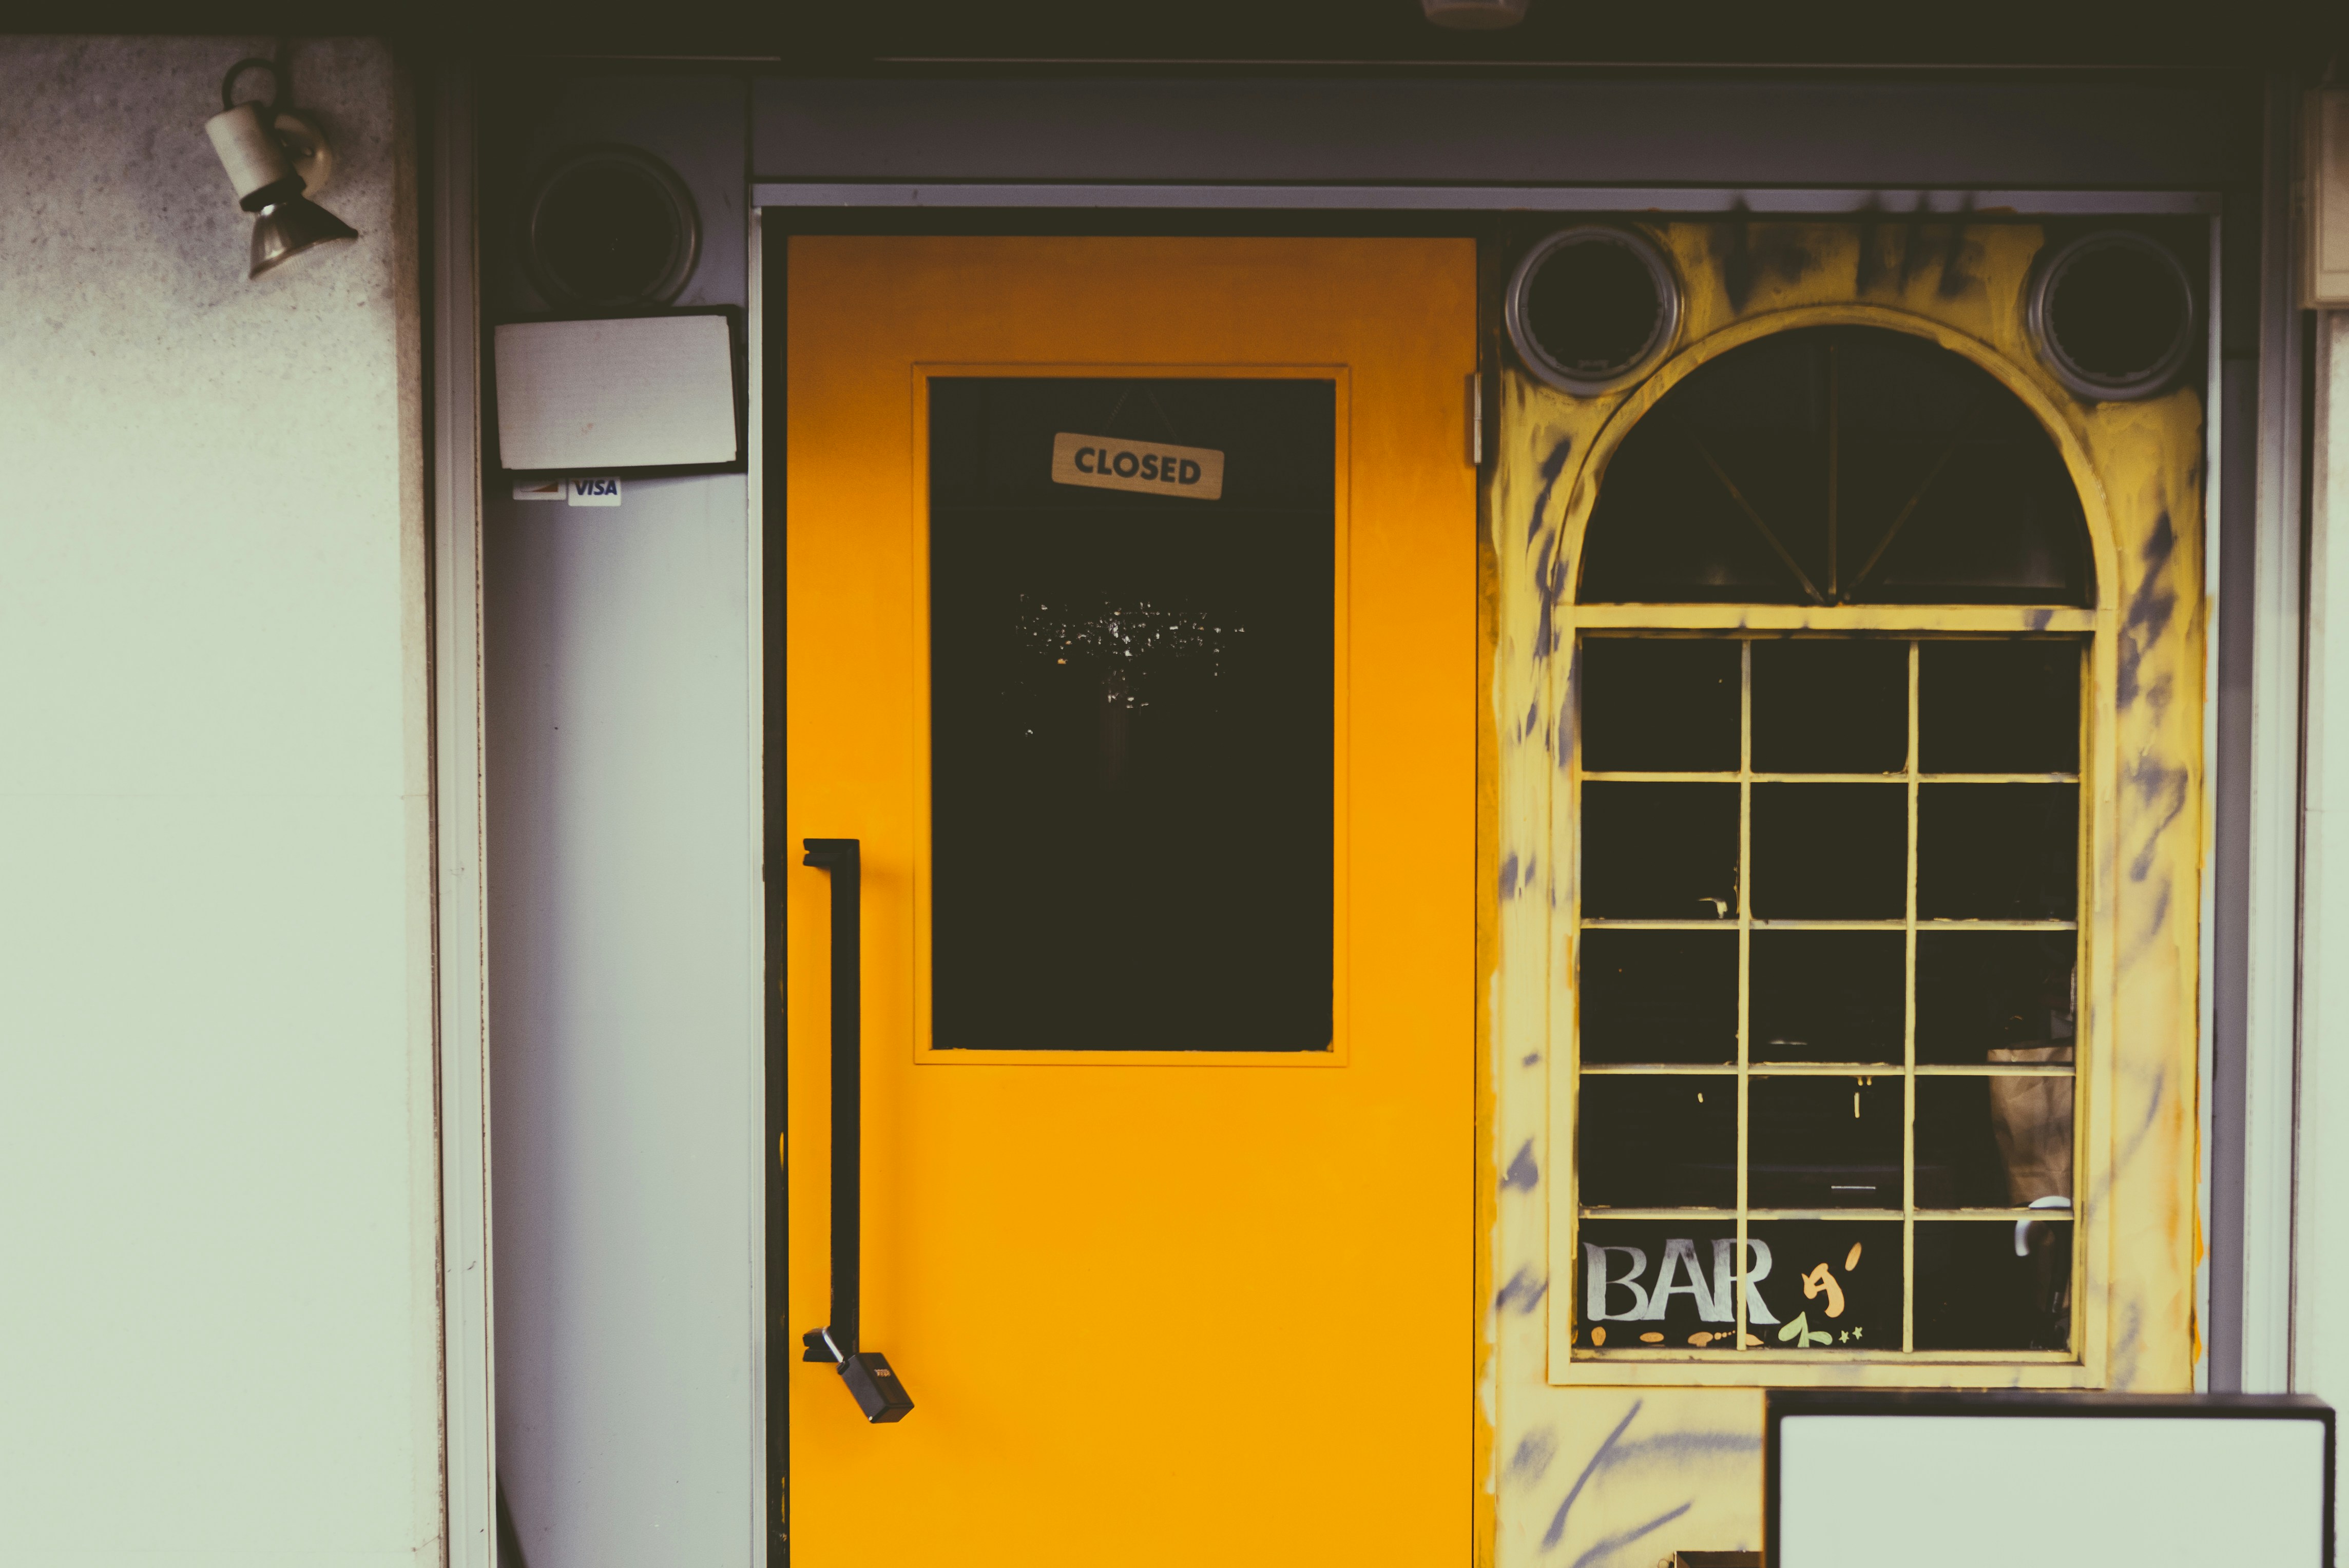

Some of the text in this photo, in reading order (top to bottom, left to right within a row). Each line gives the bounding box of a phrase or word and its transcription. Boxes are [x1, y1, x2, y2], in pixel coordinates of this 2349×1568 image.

[1074, 447, 1201, 485] CLOSED
[572, 479, 618, 495] VISA
[1583, 1238, 1781, 1324] BAR
